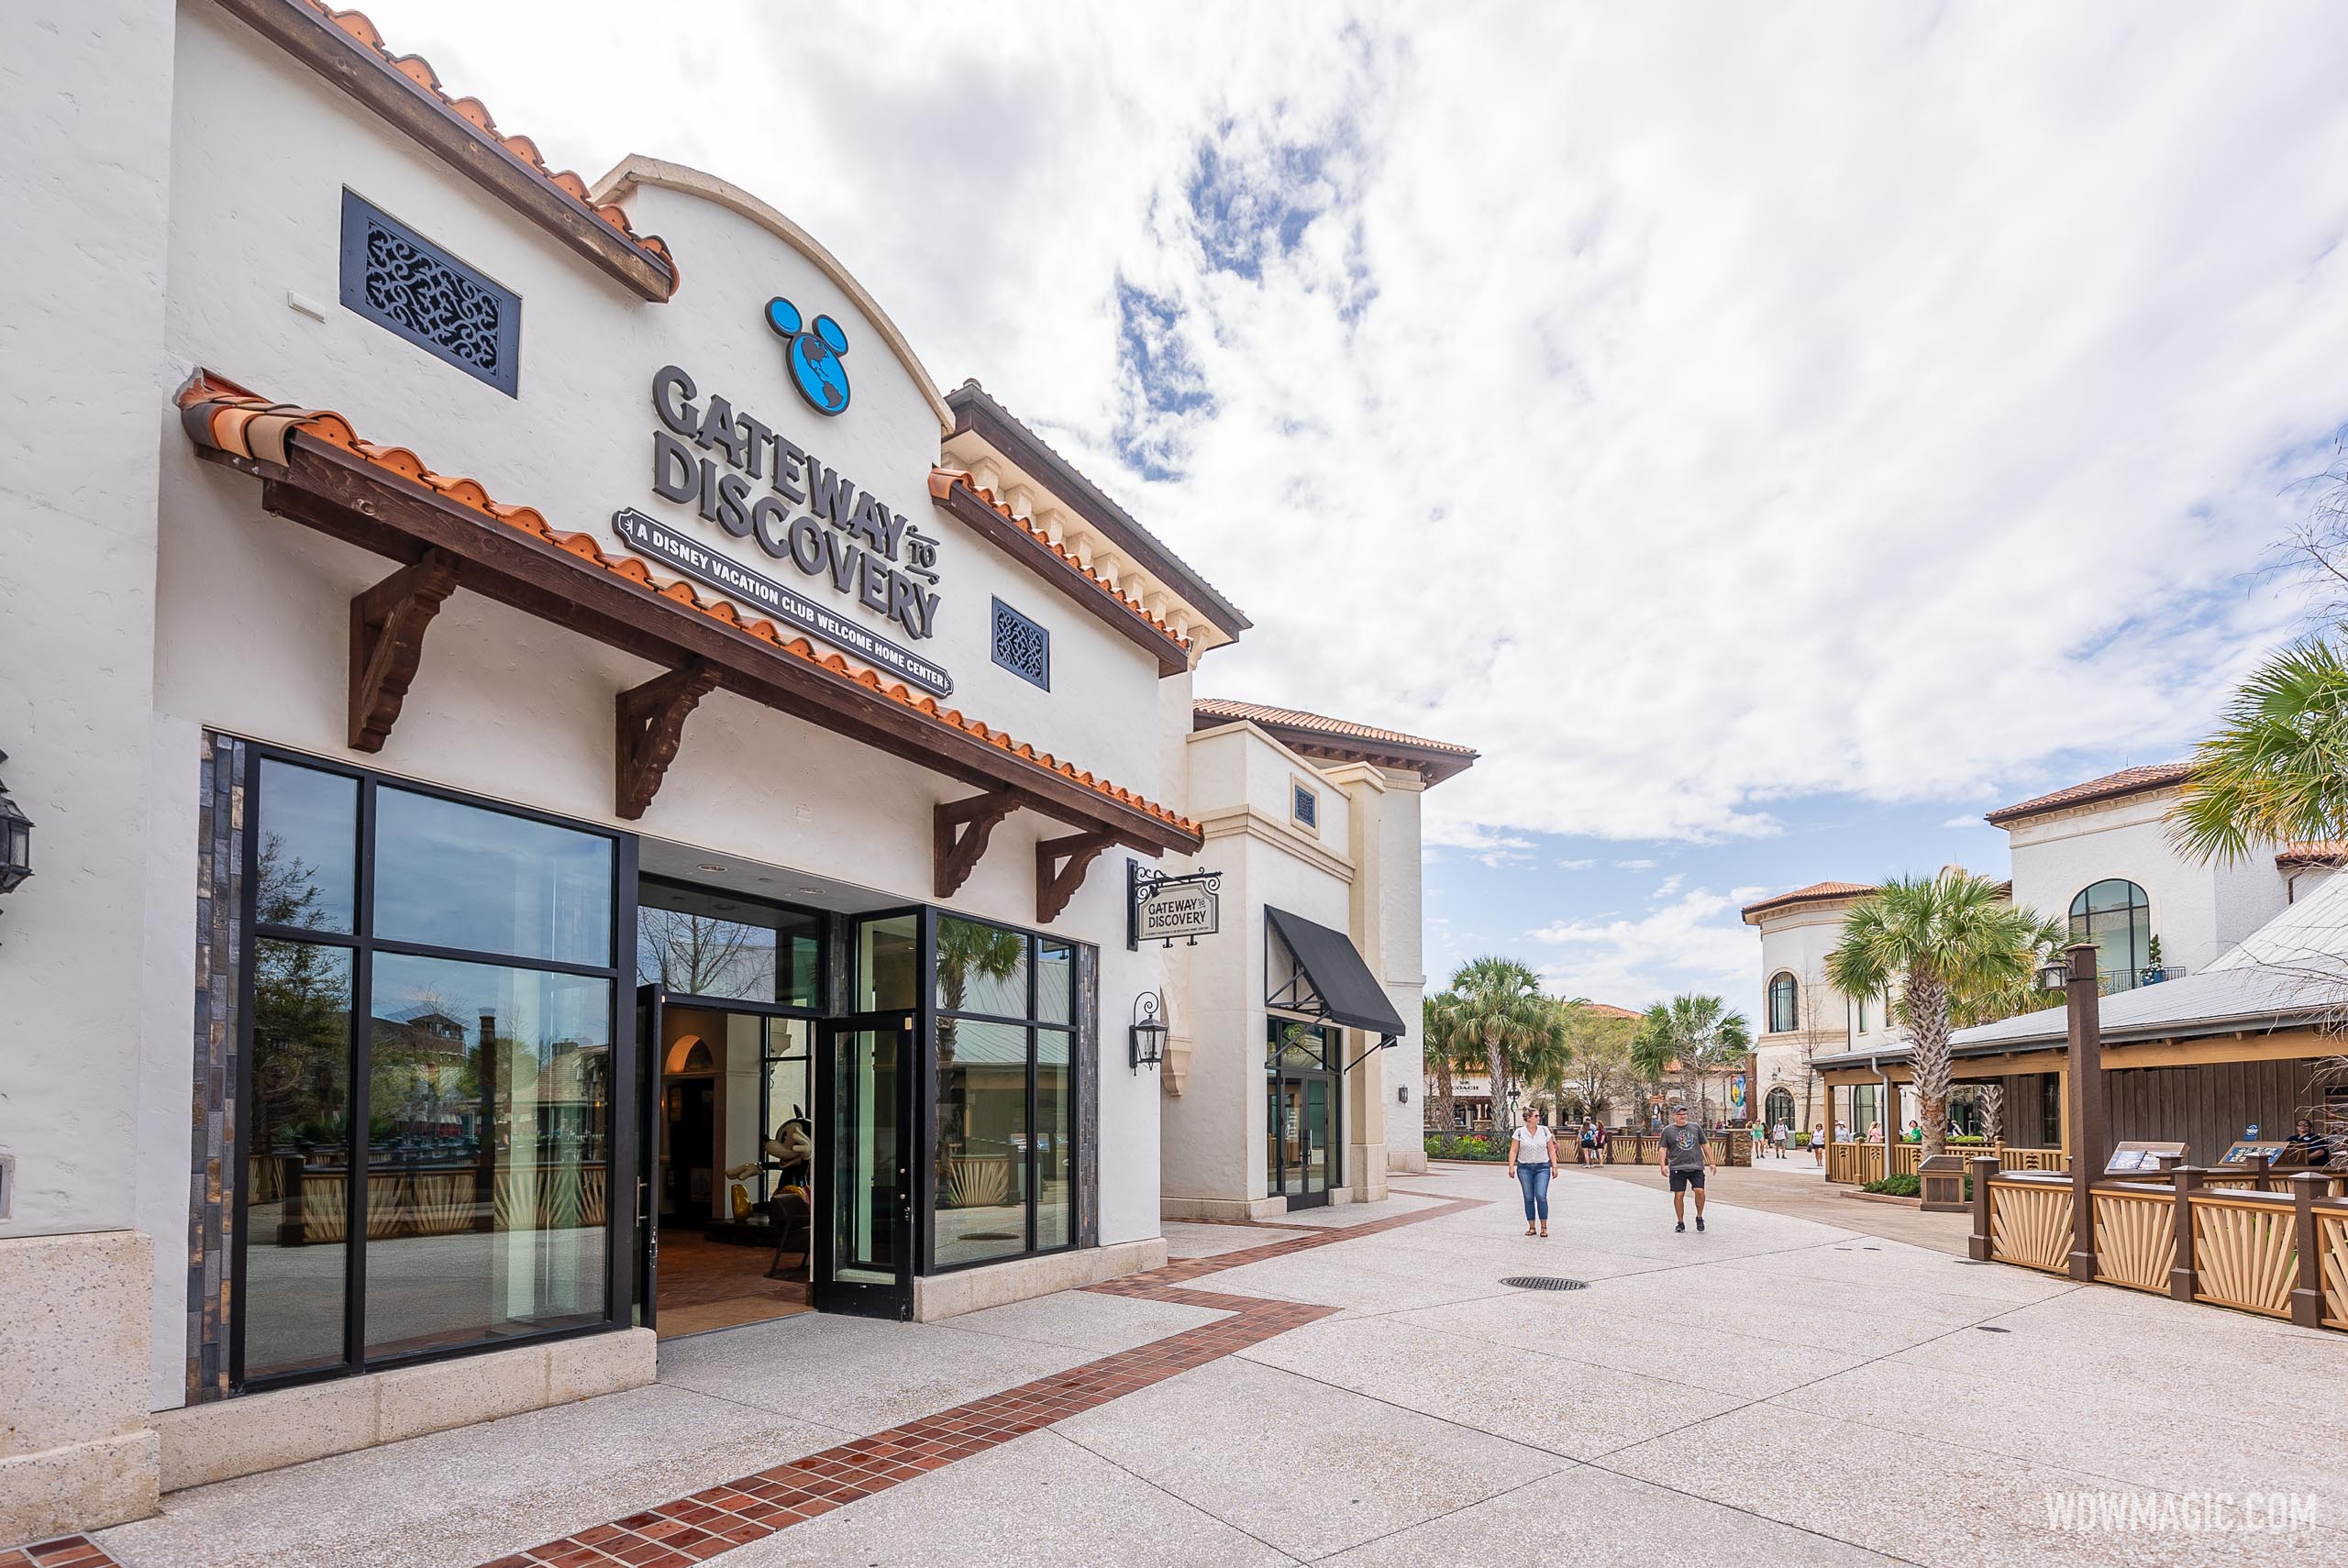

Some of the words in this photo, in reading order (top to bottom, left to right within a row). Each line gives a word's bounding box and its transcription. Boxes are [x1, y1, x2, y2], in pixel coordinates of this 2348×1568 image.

[652, 365, 908, 562] GATEWAY
[910, 542, 936, 568] TO
[652, 430, 941, 640] DISCOVERY
[637, 524, 648, 541] A
[653, 530, 709, 569] DISNEY
[712, 559, 779, 605] VACATION
[781, 596, 814, 623] CLUB
[817, 613, 872, 651] WELCOME
[874, 644, 904, 668] HOME
[906, 659, 944, 688] CENTER
[1148, 899, 1197, 915] GATEWAY
[1148, 911, 1207, 928] DISCOVERY
